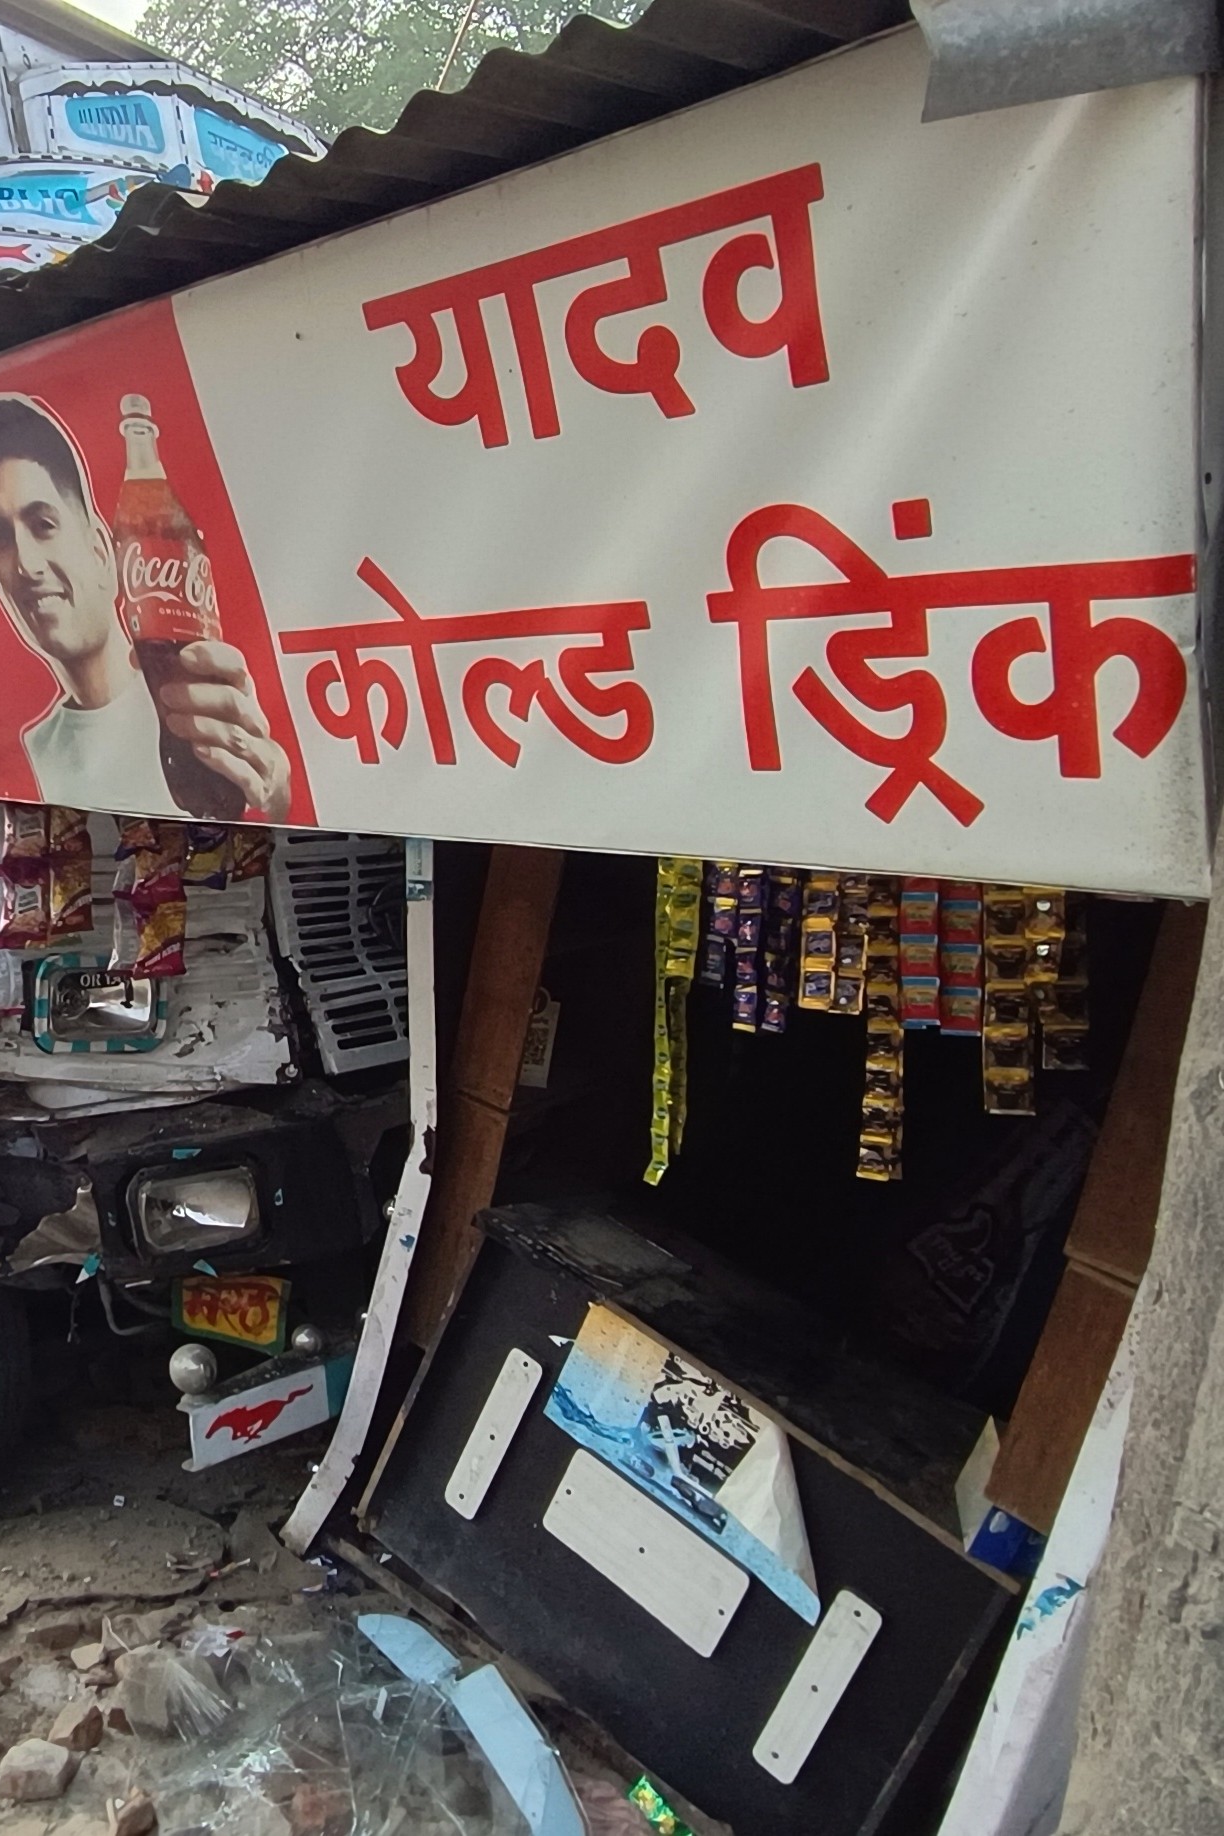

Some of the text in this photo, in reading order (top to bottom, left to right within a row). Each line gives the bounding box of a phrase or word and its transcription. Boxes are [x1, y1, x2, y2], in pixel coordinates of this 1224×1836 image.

[362, 162, 830, 449] यादव
[278, 498, 1198, 828] कोल्ड ड्रिंक
